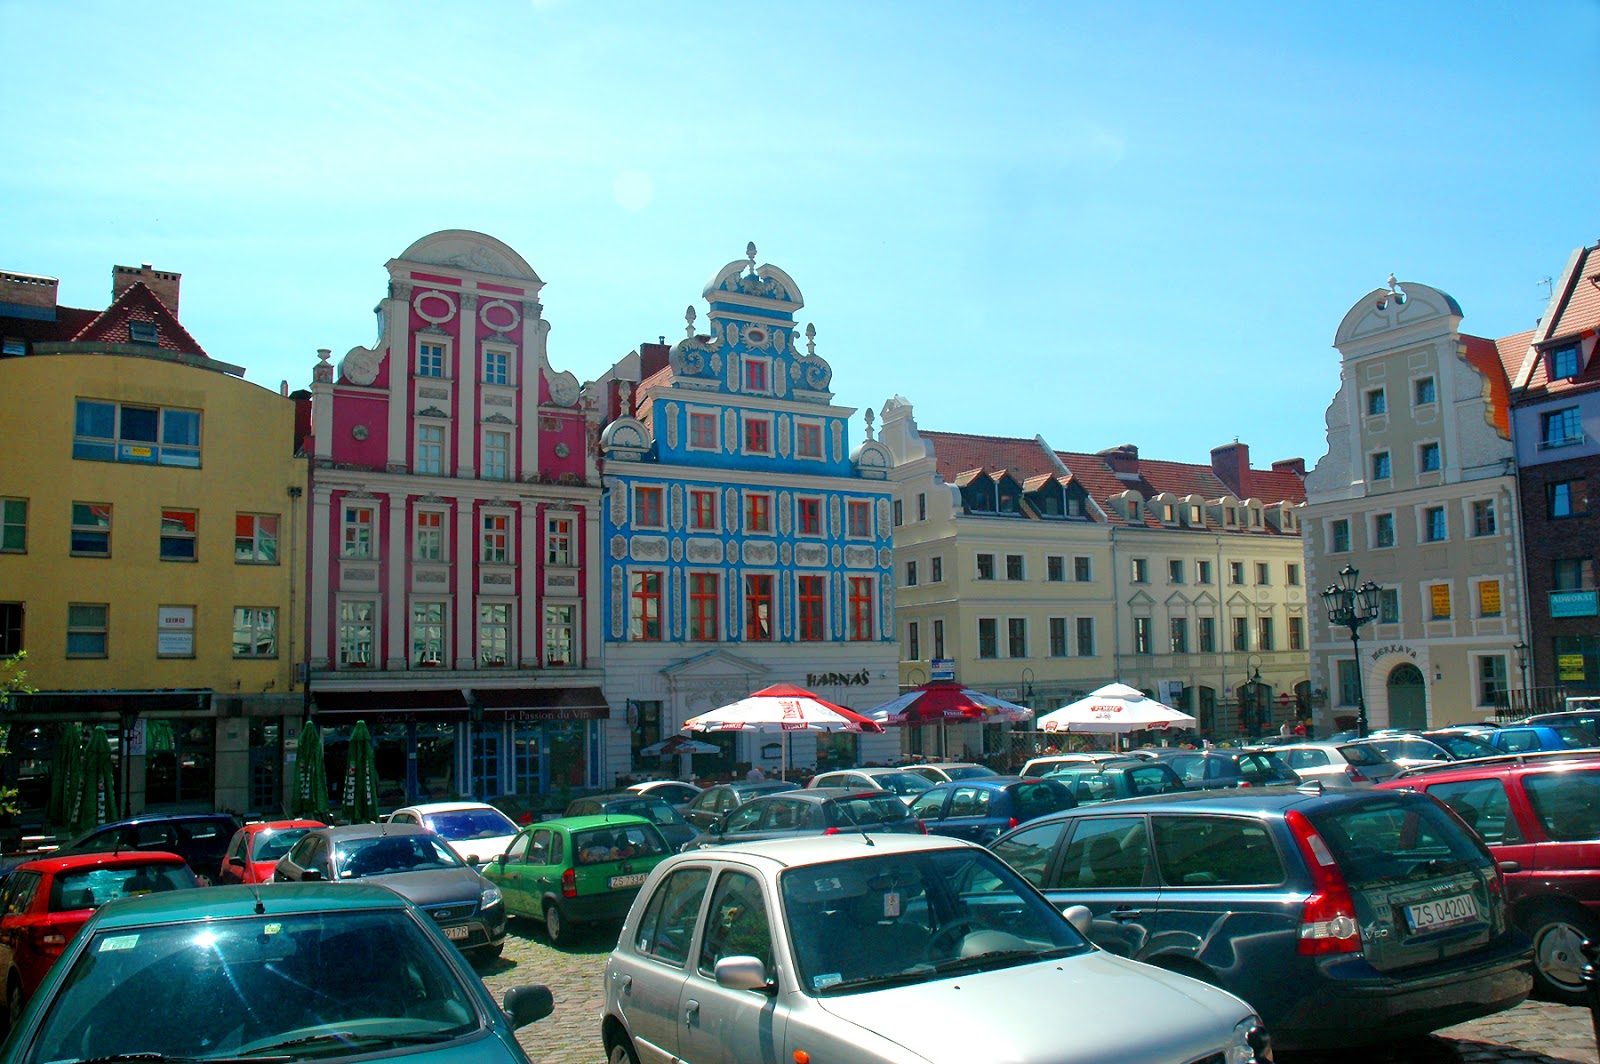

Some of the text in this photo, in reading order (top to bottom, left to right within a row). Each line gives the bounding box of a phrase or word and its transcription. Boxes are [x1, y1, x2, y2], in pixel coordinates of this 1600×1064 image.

[1553, 594, 1593, 603] ADWOKAT
[1371, 644, 1417, 661] MERKAVA
[806, 667, 870, 687] HARNAŚ
[504, 709, 589, 721] La Passion du Vin
[346, 776, 356, 806] LECH
[612, 877, 624, 887] ZS
[1412, 905, 1435, 926] ZS
[1435, 895, 1473, 921] 0420V
